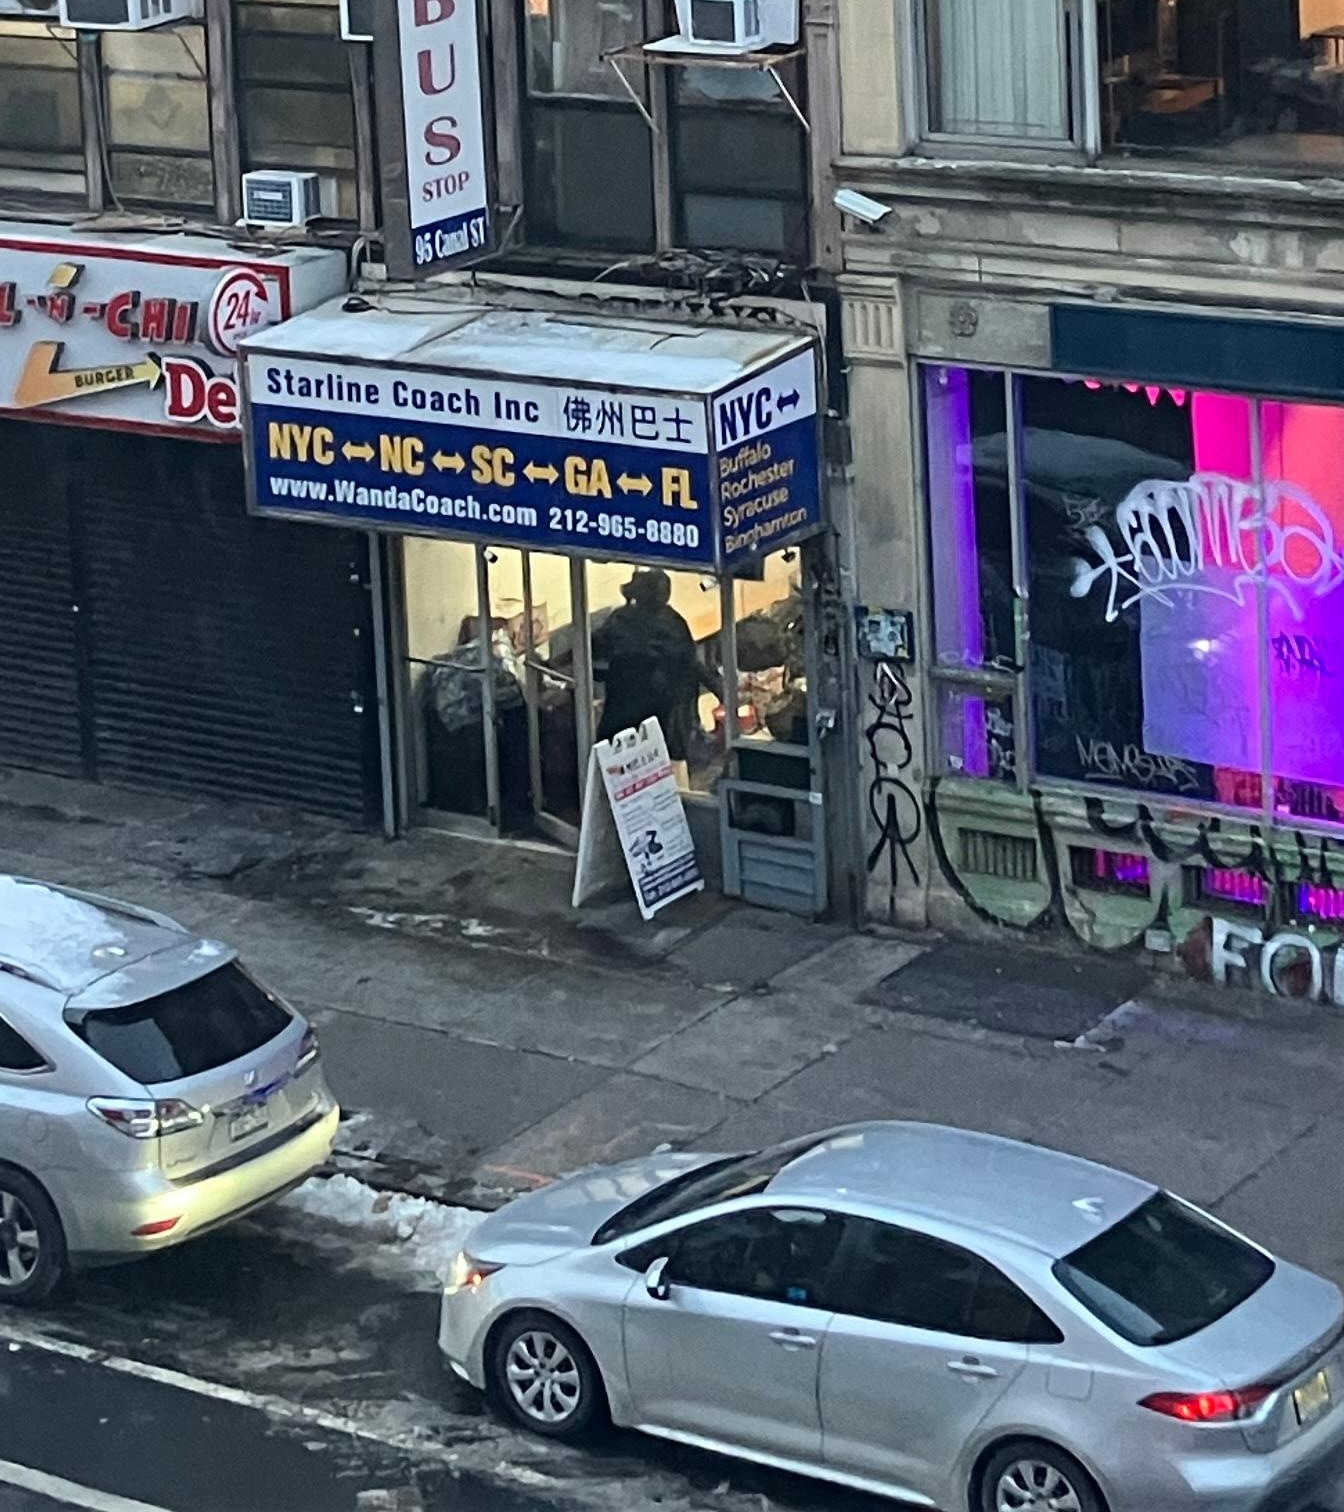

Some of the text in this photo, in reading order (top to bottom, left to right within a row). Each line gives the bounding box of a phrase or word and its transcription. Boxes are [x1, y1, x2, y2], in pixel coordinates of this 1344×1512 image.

[421, 170, 471, 203] STOP
[415, 216, 486, 265] 95 Canal ST
[223, 289, 251, 332] 24
[73, 365, 136, 389] BURGER
[164, 361, 239, 425] De
[267, 367, 540, 424] Starline Coach Inc
[562, 394, 694, 444] 佛州巴士
[719, 387, 773, 446] NYC
[268, 421, 699, 510] NYC NC SC GA FL
[719, 439, 773, 479] Buffalo
[720, 458, 796, 502] Rochester
[269, 475, 700, 548] www.WandaCoach.com 212-965-8880
[722, 486, 790, 529] Syracuse
[724, 505, 808, 555] Binghamton
